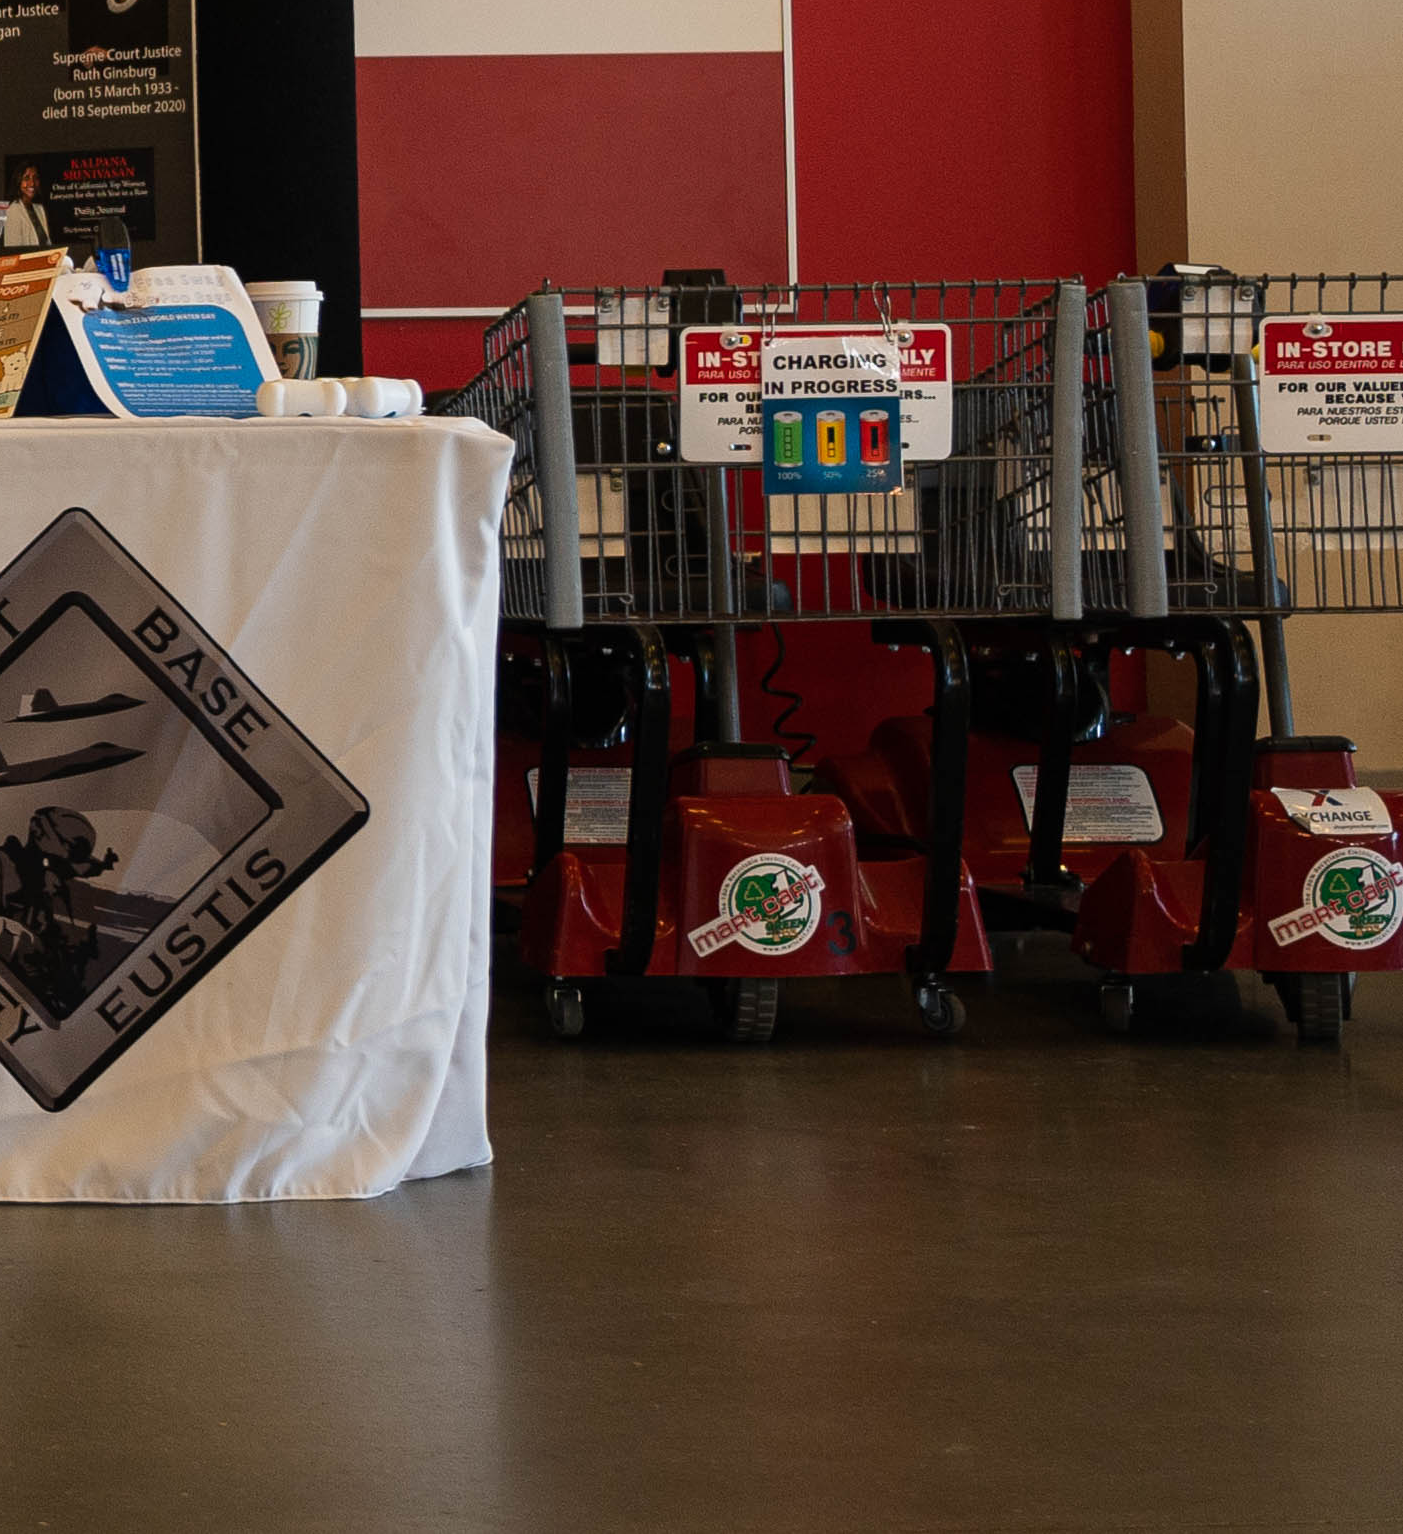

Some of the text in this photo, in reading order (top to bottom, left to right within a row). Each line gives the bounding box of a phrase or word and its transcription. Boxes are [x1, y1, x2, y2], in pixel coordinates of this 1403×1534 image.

[15, 2, 59, 18] Justice
[73, 65, 157, 82] Ruth Ginsburg
[105, 83, 141, 98] March
[42, 101, 153, 121] died September
[1277, 341, 1392, 358] IN-STORE
[773, 354, 887, 371] CHARGING
[765, 379, 897, 395] IN PROGRESS
[1315, 382, 1346, 392] OUR
[1326, 394, 1395, 404] BECAUSE
[131, 606, 271, 751] BASE
[95, 847, 287, 1035] EUSTIS
[828, 911, 856, 957] 3
